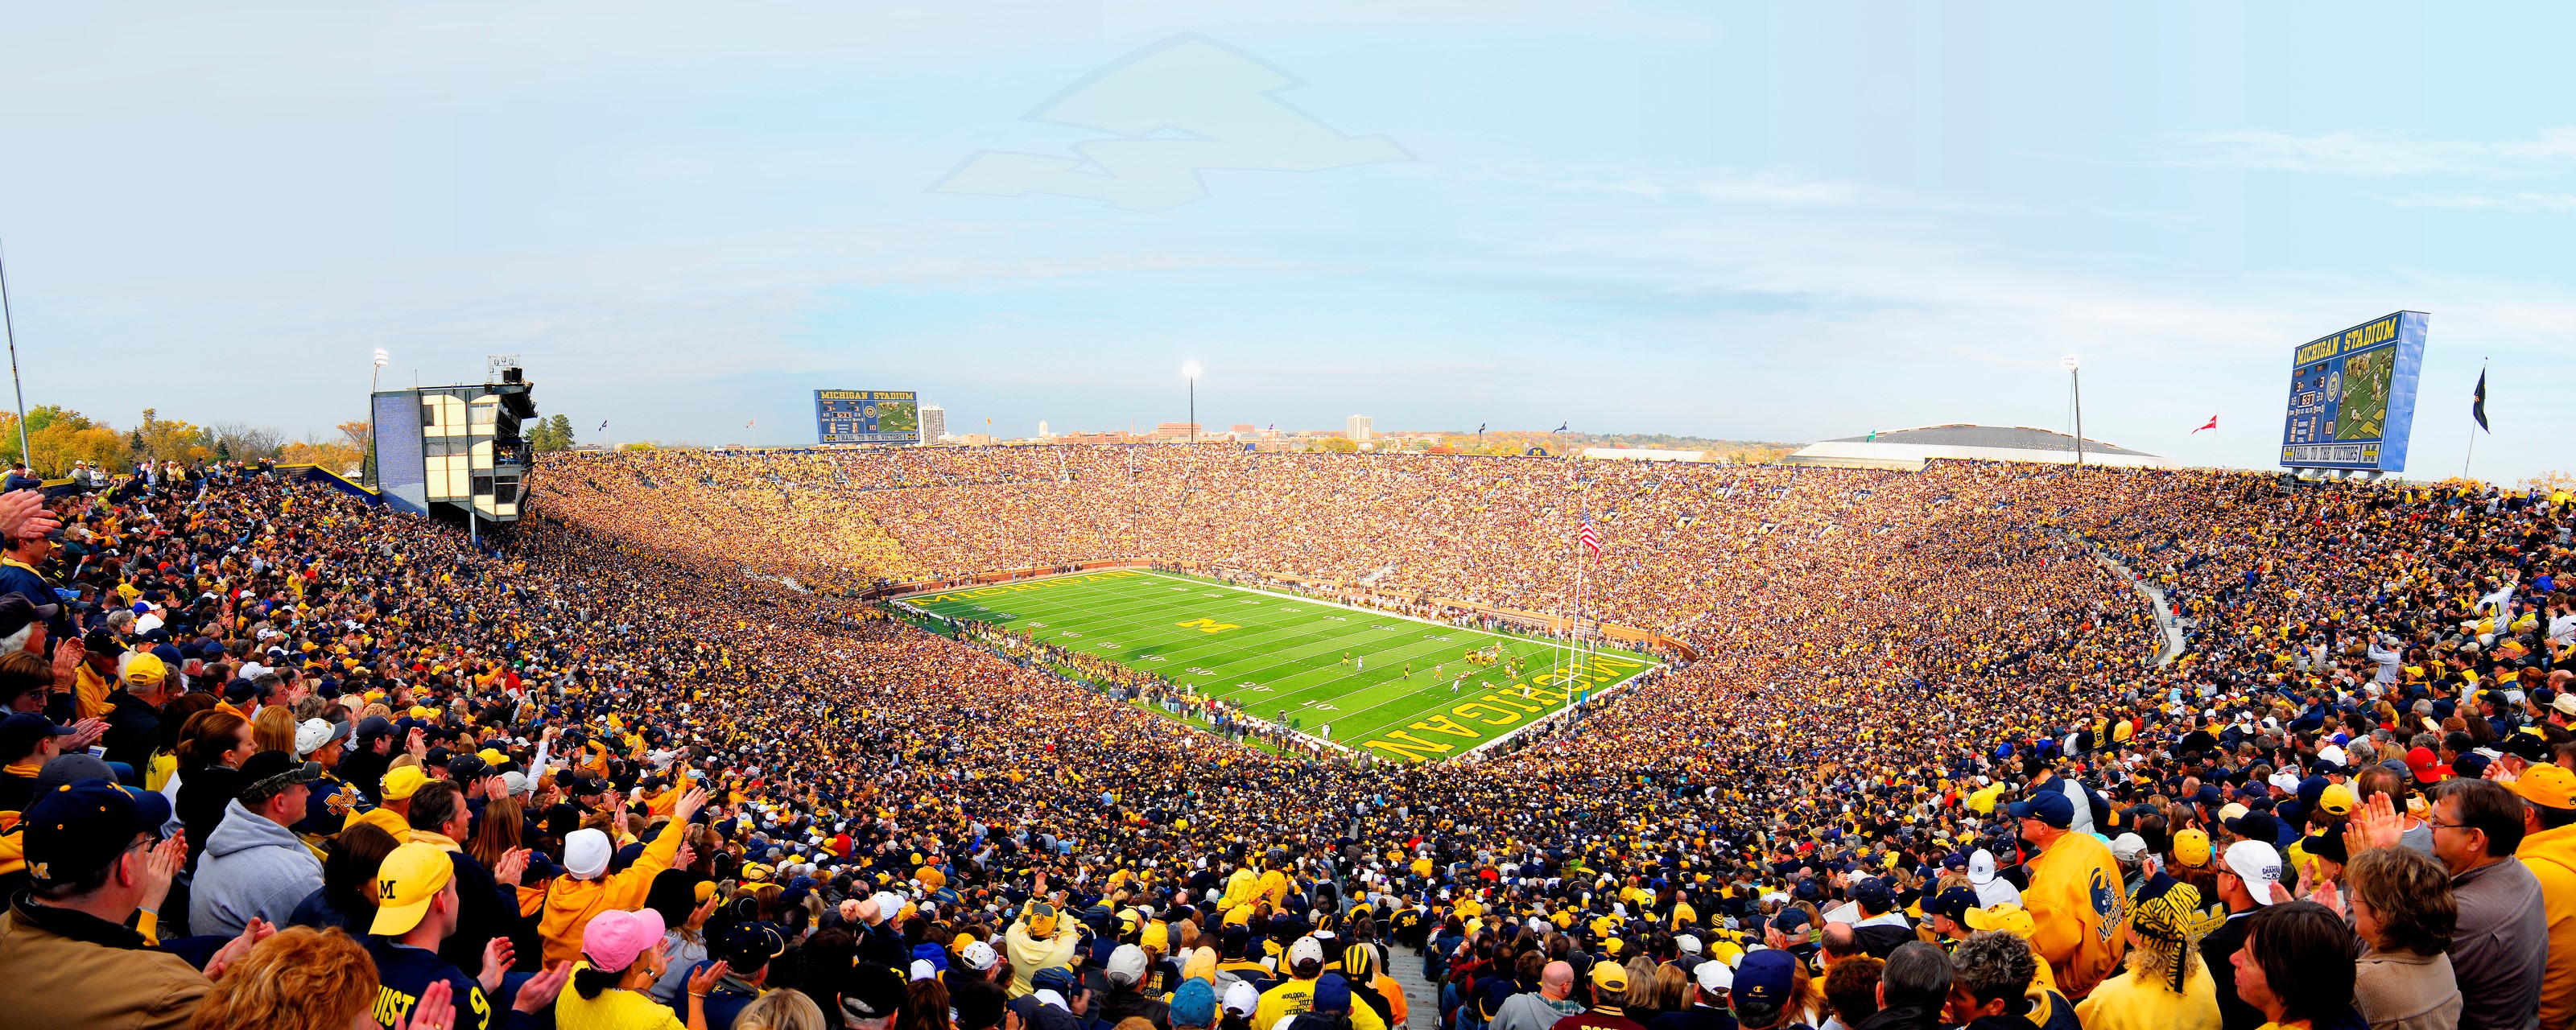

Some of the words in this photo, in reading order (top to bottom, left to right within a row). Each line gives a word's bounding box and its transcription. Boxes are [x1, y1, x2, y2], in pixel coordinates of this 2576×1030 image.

[2296, 336, 2339, 366] MICHIGAN
[2344, 317, 2397, 352] STADIUM
[2297, 381, 2301, 392] 3
[2320, 376, 2325, 388] 3
[821, 391, 868, 400] MICHIGAN
[873, 392, 914, 400] STADIUM
[2325, 422, 2334, 435] 10
[2296, 447, 2308, 460] HAIL
[2311, 447, 2318, 460] TO
[2320, 447, 2330, 460] THE
[2334, 447, 2358, 461] VICTORS
[906, 570, 1140, 606] MICHIGAN
[1174, 617, 1243, 633] M
[1185, 666, 1214, 677] 30
[1236, 682, 1270, 693] 20
[1298, 699, 1334, 711] 10
[1360, 655, 1646, 763] MICHIGAN
[2095, 732, 2102, 740] 6
[1098, 832, 1107, 842] 34
[27, 860, 51, 880] M
[379, 880, 396, 899] M
[1402, 914, 1418, 927] M
[2194, 919, 2224, 933] MICHIGAN
[470, 986, 491, 1030] 9
